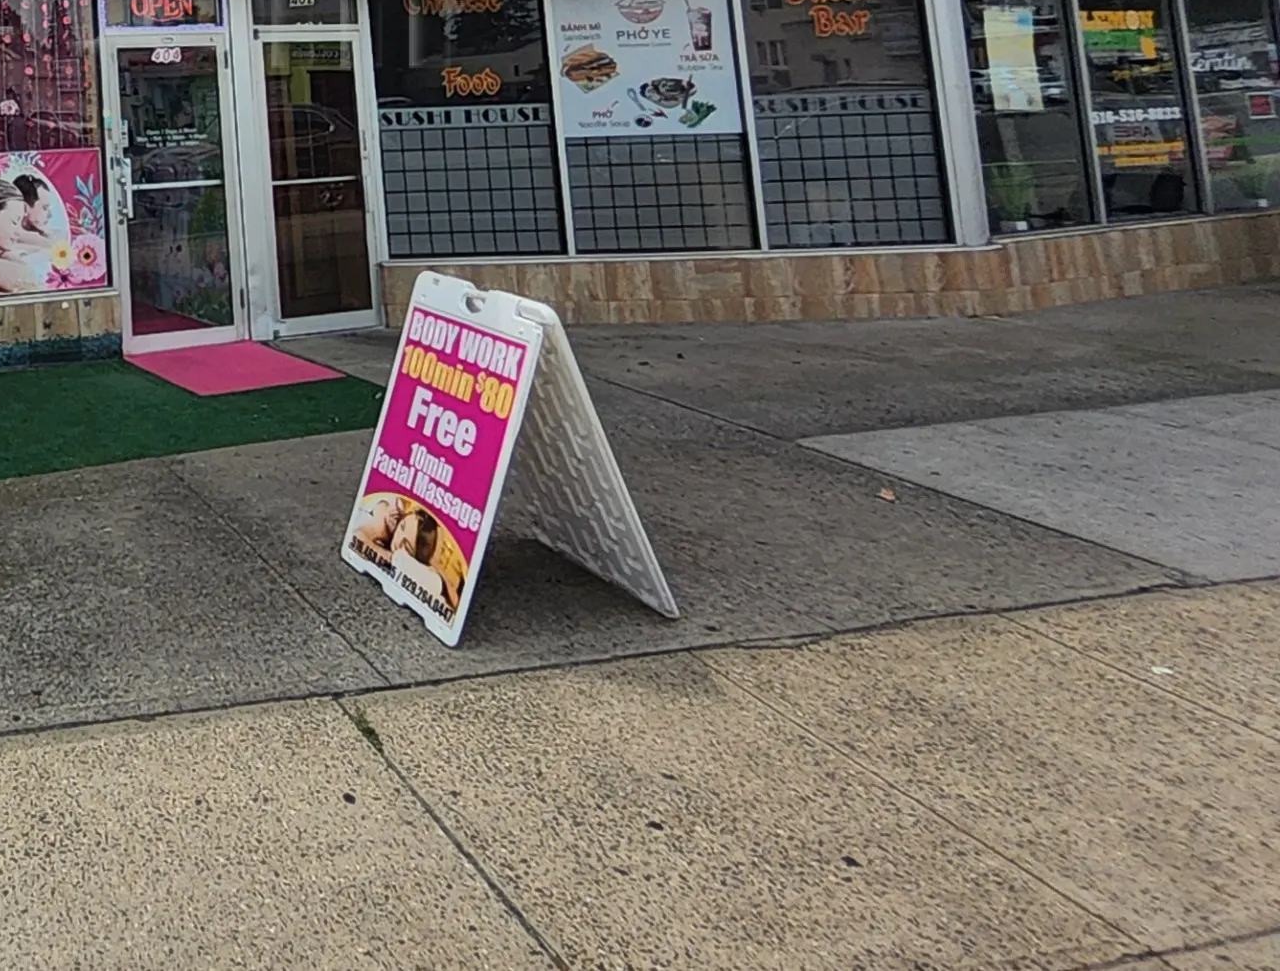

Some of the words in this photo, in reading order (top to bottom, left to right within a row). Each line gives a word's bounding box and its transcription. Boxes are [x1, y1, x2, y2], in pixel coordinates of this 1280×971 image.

[652, 28, 672, 40] YE
[809, 5, 870, 38] Bar
[152, 47, 182, 64] 404
[442, 66, 502, 99] Food
[381, 109, 452, 127] SUSHI
[464, 107, 548, 125] HOUSE
[408, 311, 457, 354] BODY
[459, 328, 523, 381] WORK
[401, 346, 475, 405] 100min
[475, 372, 515, 421] $80
[407, 387, 477, 457] Free
[410, 441, 454, 488] 10min
[373, 446, 412, 492] Facial
[413, 471, 482, 531] Massage
